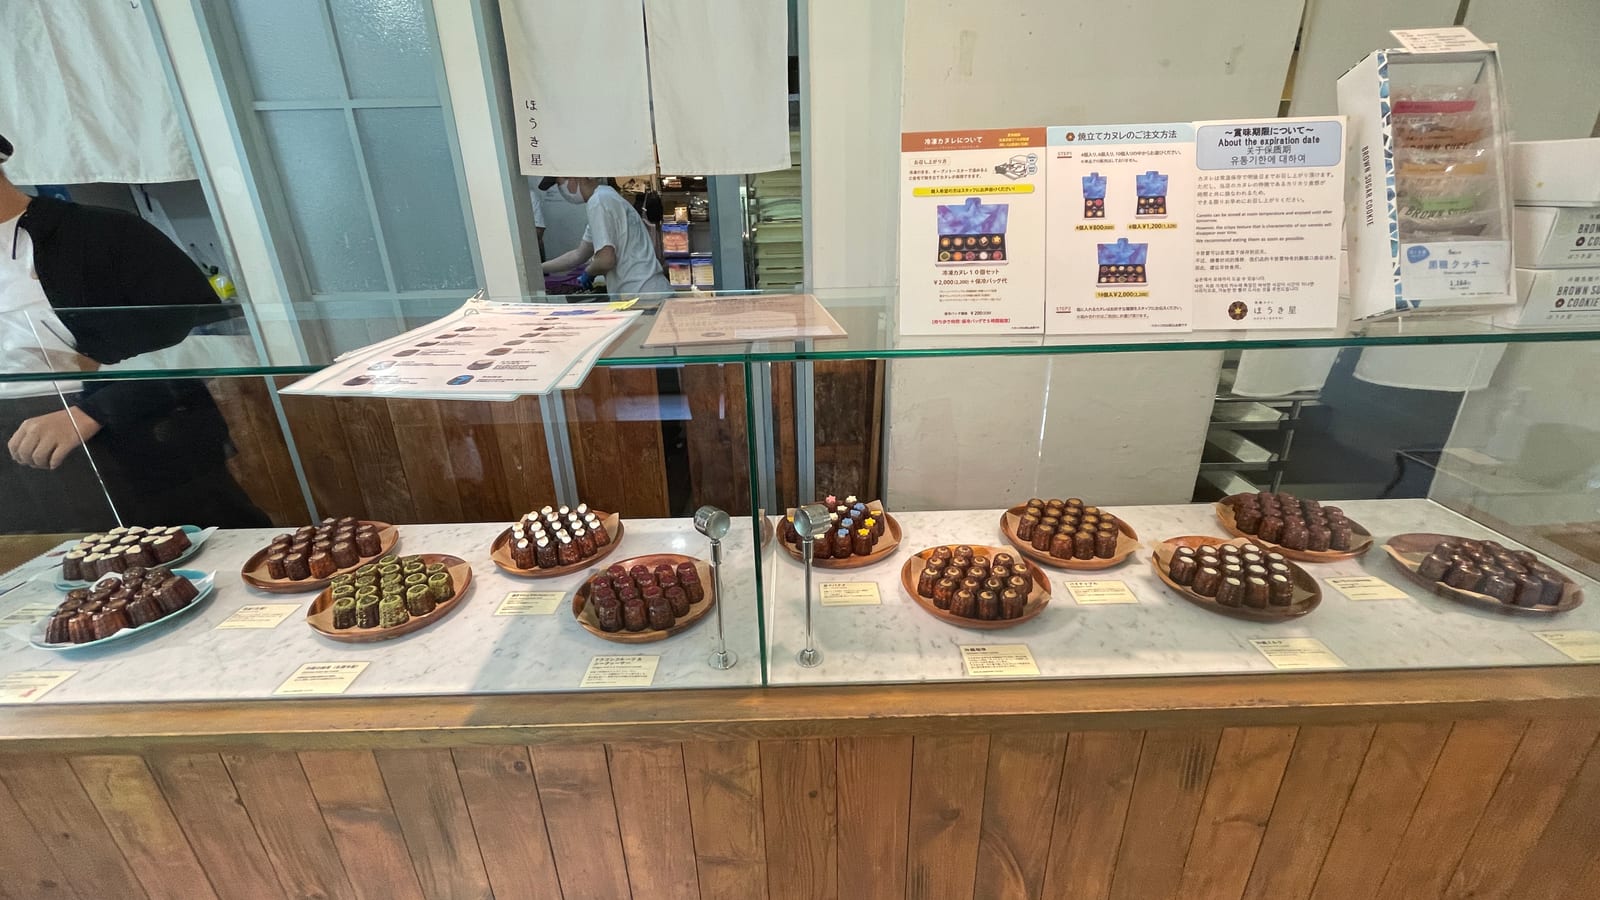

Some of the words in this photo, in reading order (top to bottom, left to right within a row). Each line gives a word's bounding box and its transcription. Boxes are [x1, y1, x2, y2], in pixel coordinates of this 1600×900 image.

[525, 99, 543, 166] ほうき星
[1077, 130, 1177, 141] 焼立てカヌレのご注文方法
[924, 136, 983, 145] 冷凍カヌレについて
[1218, 138, 1242, 147] About
[1245, 137, 1257, 146] the
[1260, 136, 1300, 147] expiration
[1302, 135, 1320, 144] date
[1279, 154, 1306, 164] 대하여
[1361, 145, 1371, 174] BROWN
[1364, 173, 1373, 199] SUGAR
[1365, 199, 1374, 227] COOKIE
[1556, 286, 1589, 296] BROWN
[1566, 297, 1600, 308] COOKIE
[1253, 305, 1297, 314] ほうき星
